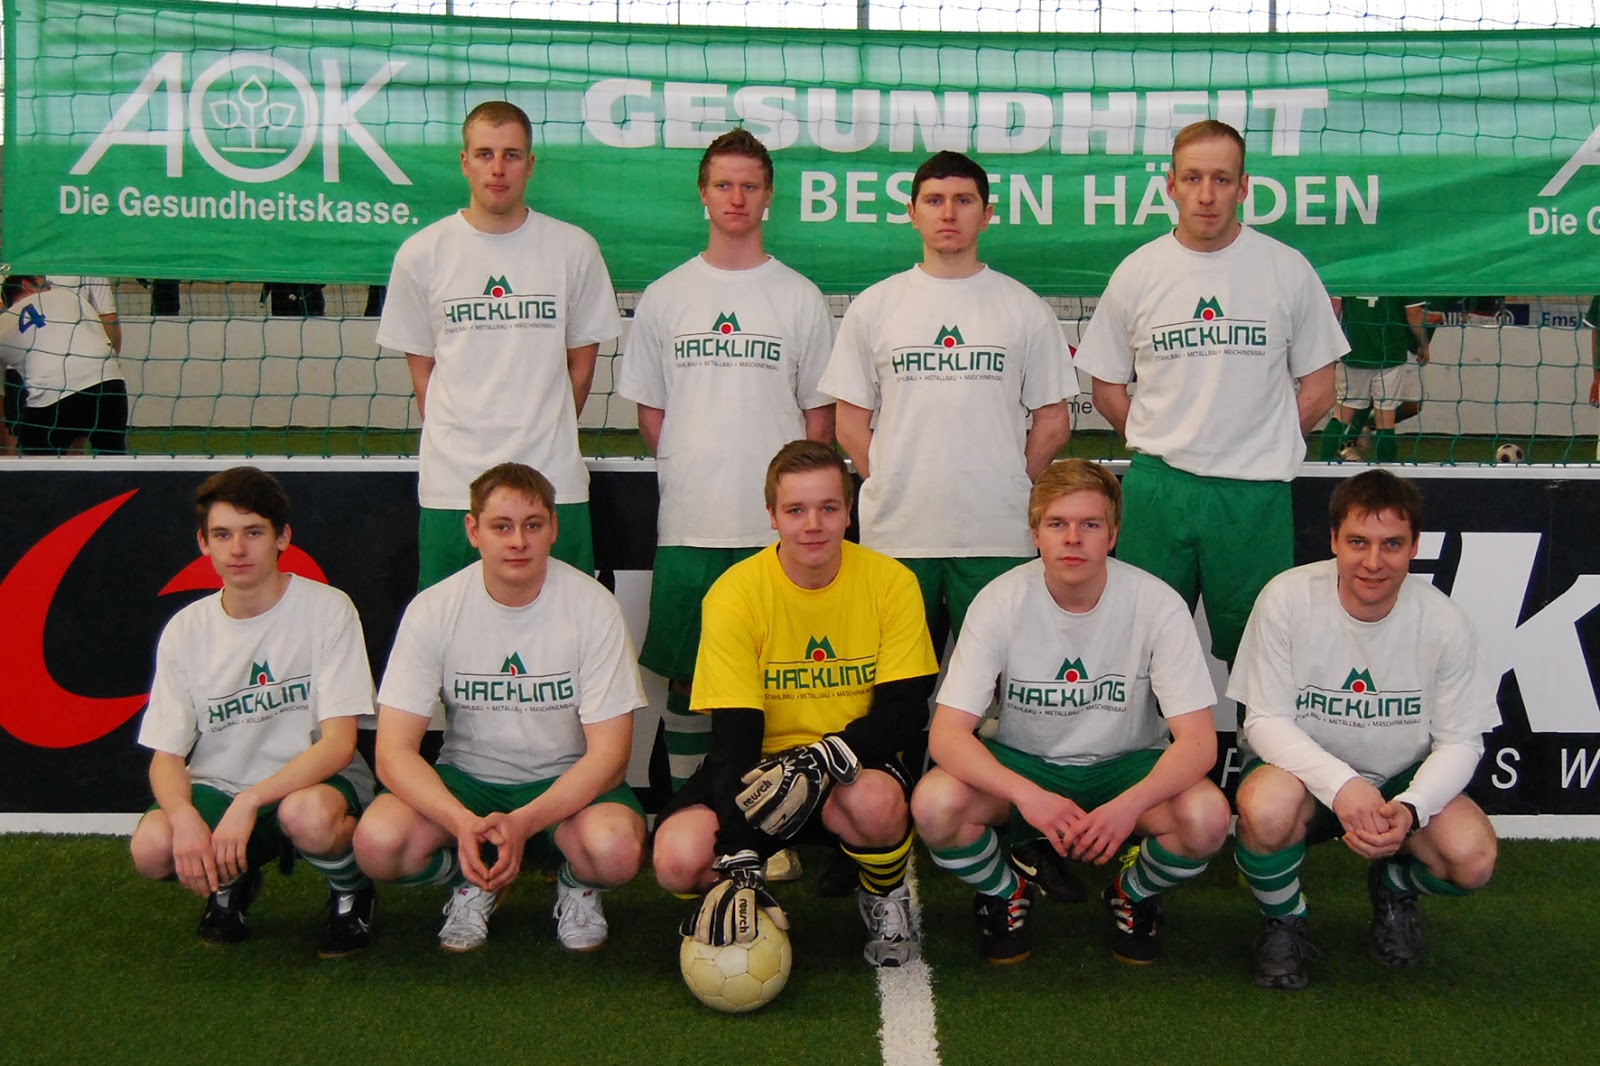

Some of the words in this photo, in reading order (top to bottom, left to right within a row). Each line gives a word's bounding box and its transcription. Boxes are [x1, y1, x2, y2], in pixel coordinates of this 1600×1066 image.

[69, 52, 414, 185] AOK
[582, 78, 1328, 156] GESUNDHEIT
[59, 185, 108, 215] Die
[118, 186, 419, 225] Gesundheitskasse.
[800, 171, 1053, 226] BESN
[1083, 162, 1379, 226] HÄDEN
[1528, 207, 1578, 235] Die
[18, 303, 47, 334] 4
[443, 301, 557, 323] HACKLING
[674, 338, 782, 361] HACKLING
[1152, 325, 1267, 352] HACKLING
[892, 351, 1006, 374] HACKLING
[764, 662, 877, 690] HACKLING
[1007, 680, 1126, 707] HACKLING
[1296, 691, 1422, 719] HACKLING
[743, 779, 773, 807] reusch
[738, 898, 749, 933] reusch
